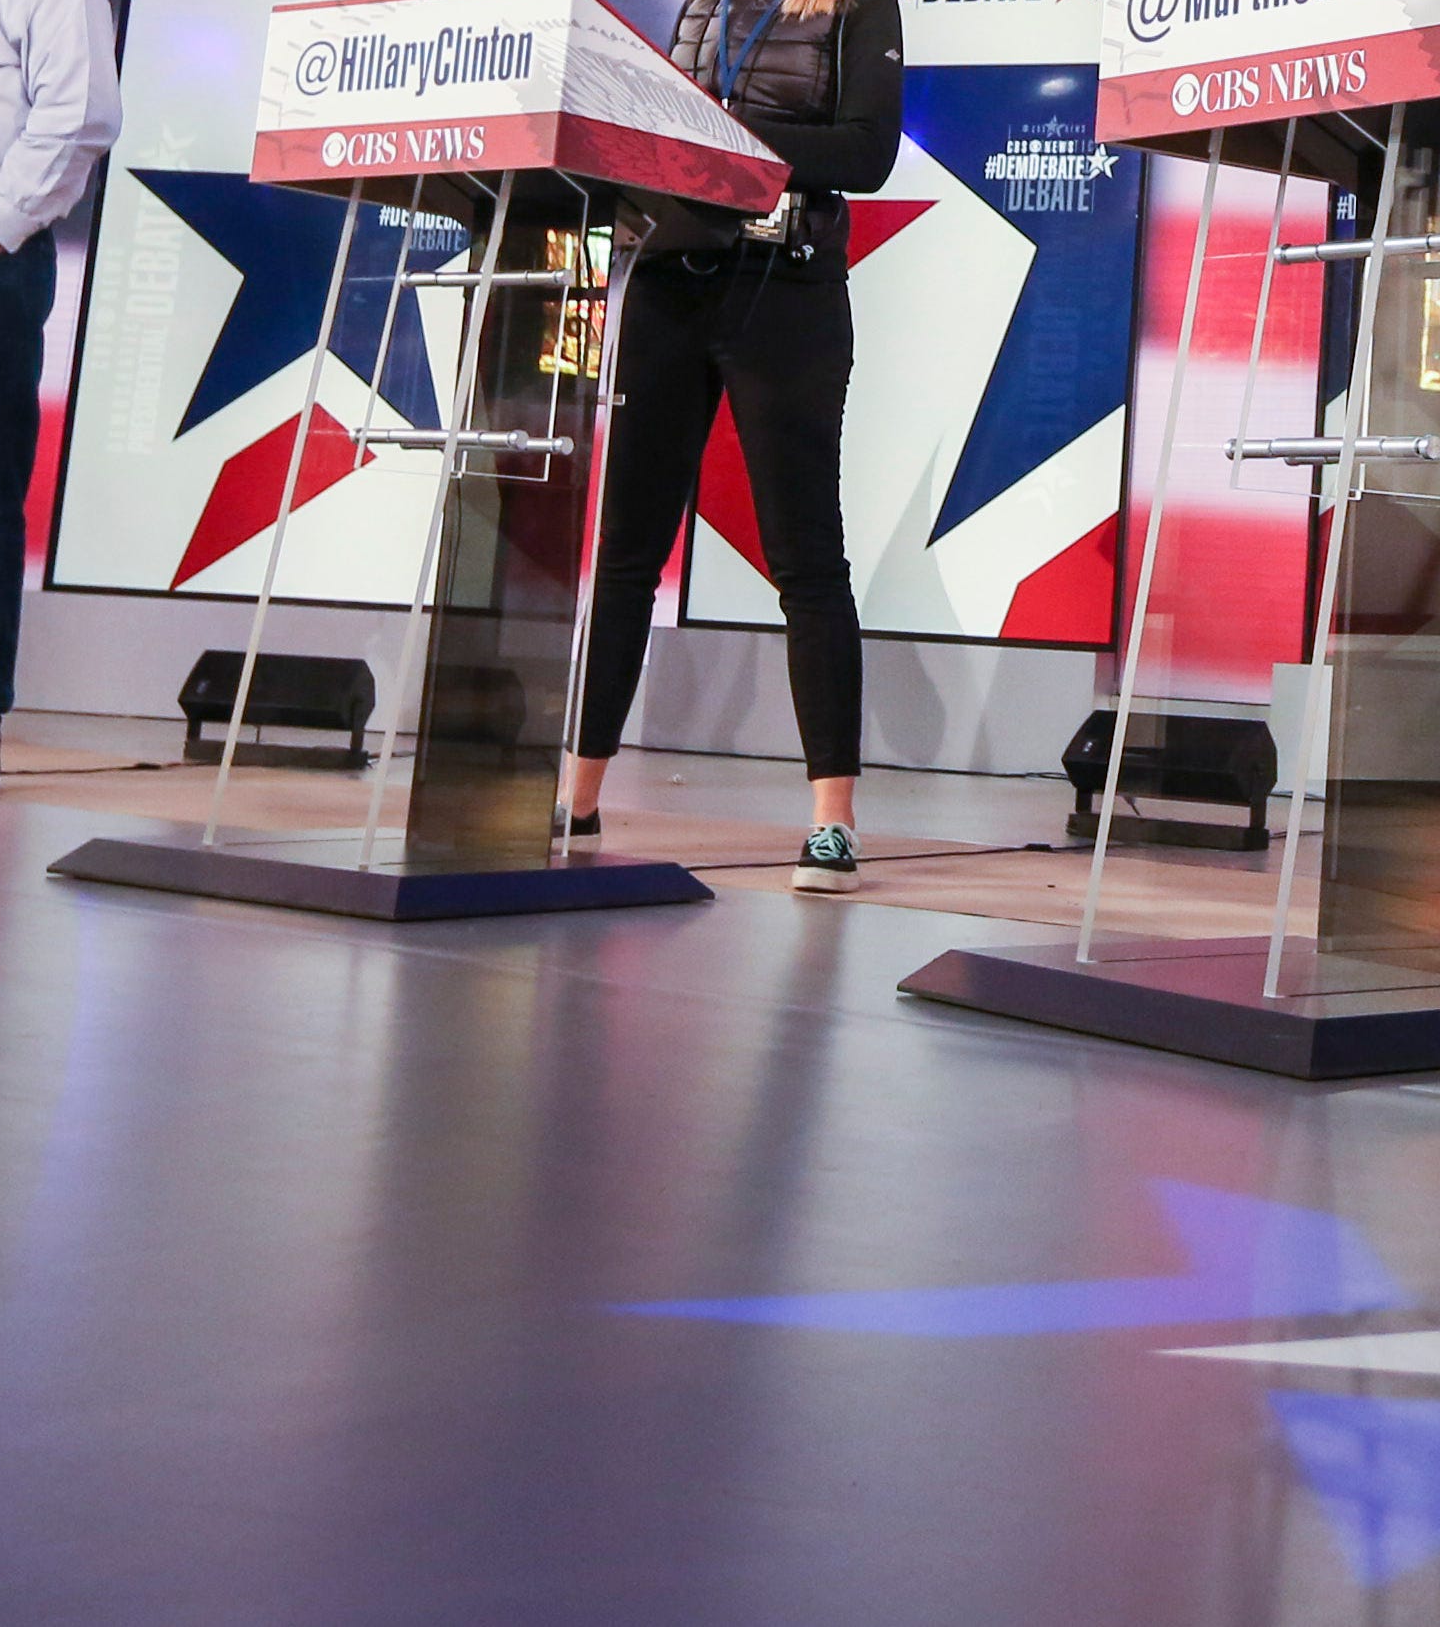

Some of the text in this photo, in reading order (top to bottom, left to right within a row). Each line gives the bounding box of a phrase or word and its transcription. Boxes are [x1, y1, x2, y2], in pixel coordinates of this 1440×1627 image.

[296, 26, 533, 96] @HillaryClinton
[1201, 49, 1367, 113] CBS NEWS
[347, 125, 485, 166] CBS NEWS
[1007, 140, 1027, 154] CBS
[1043, 140, 1075, 154] NEWS
